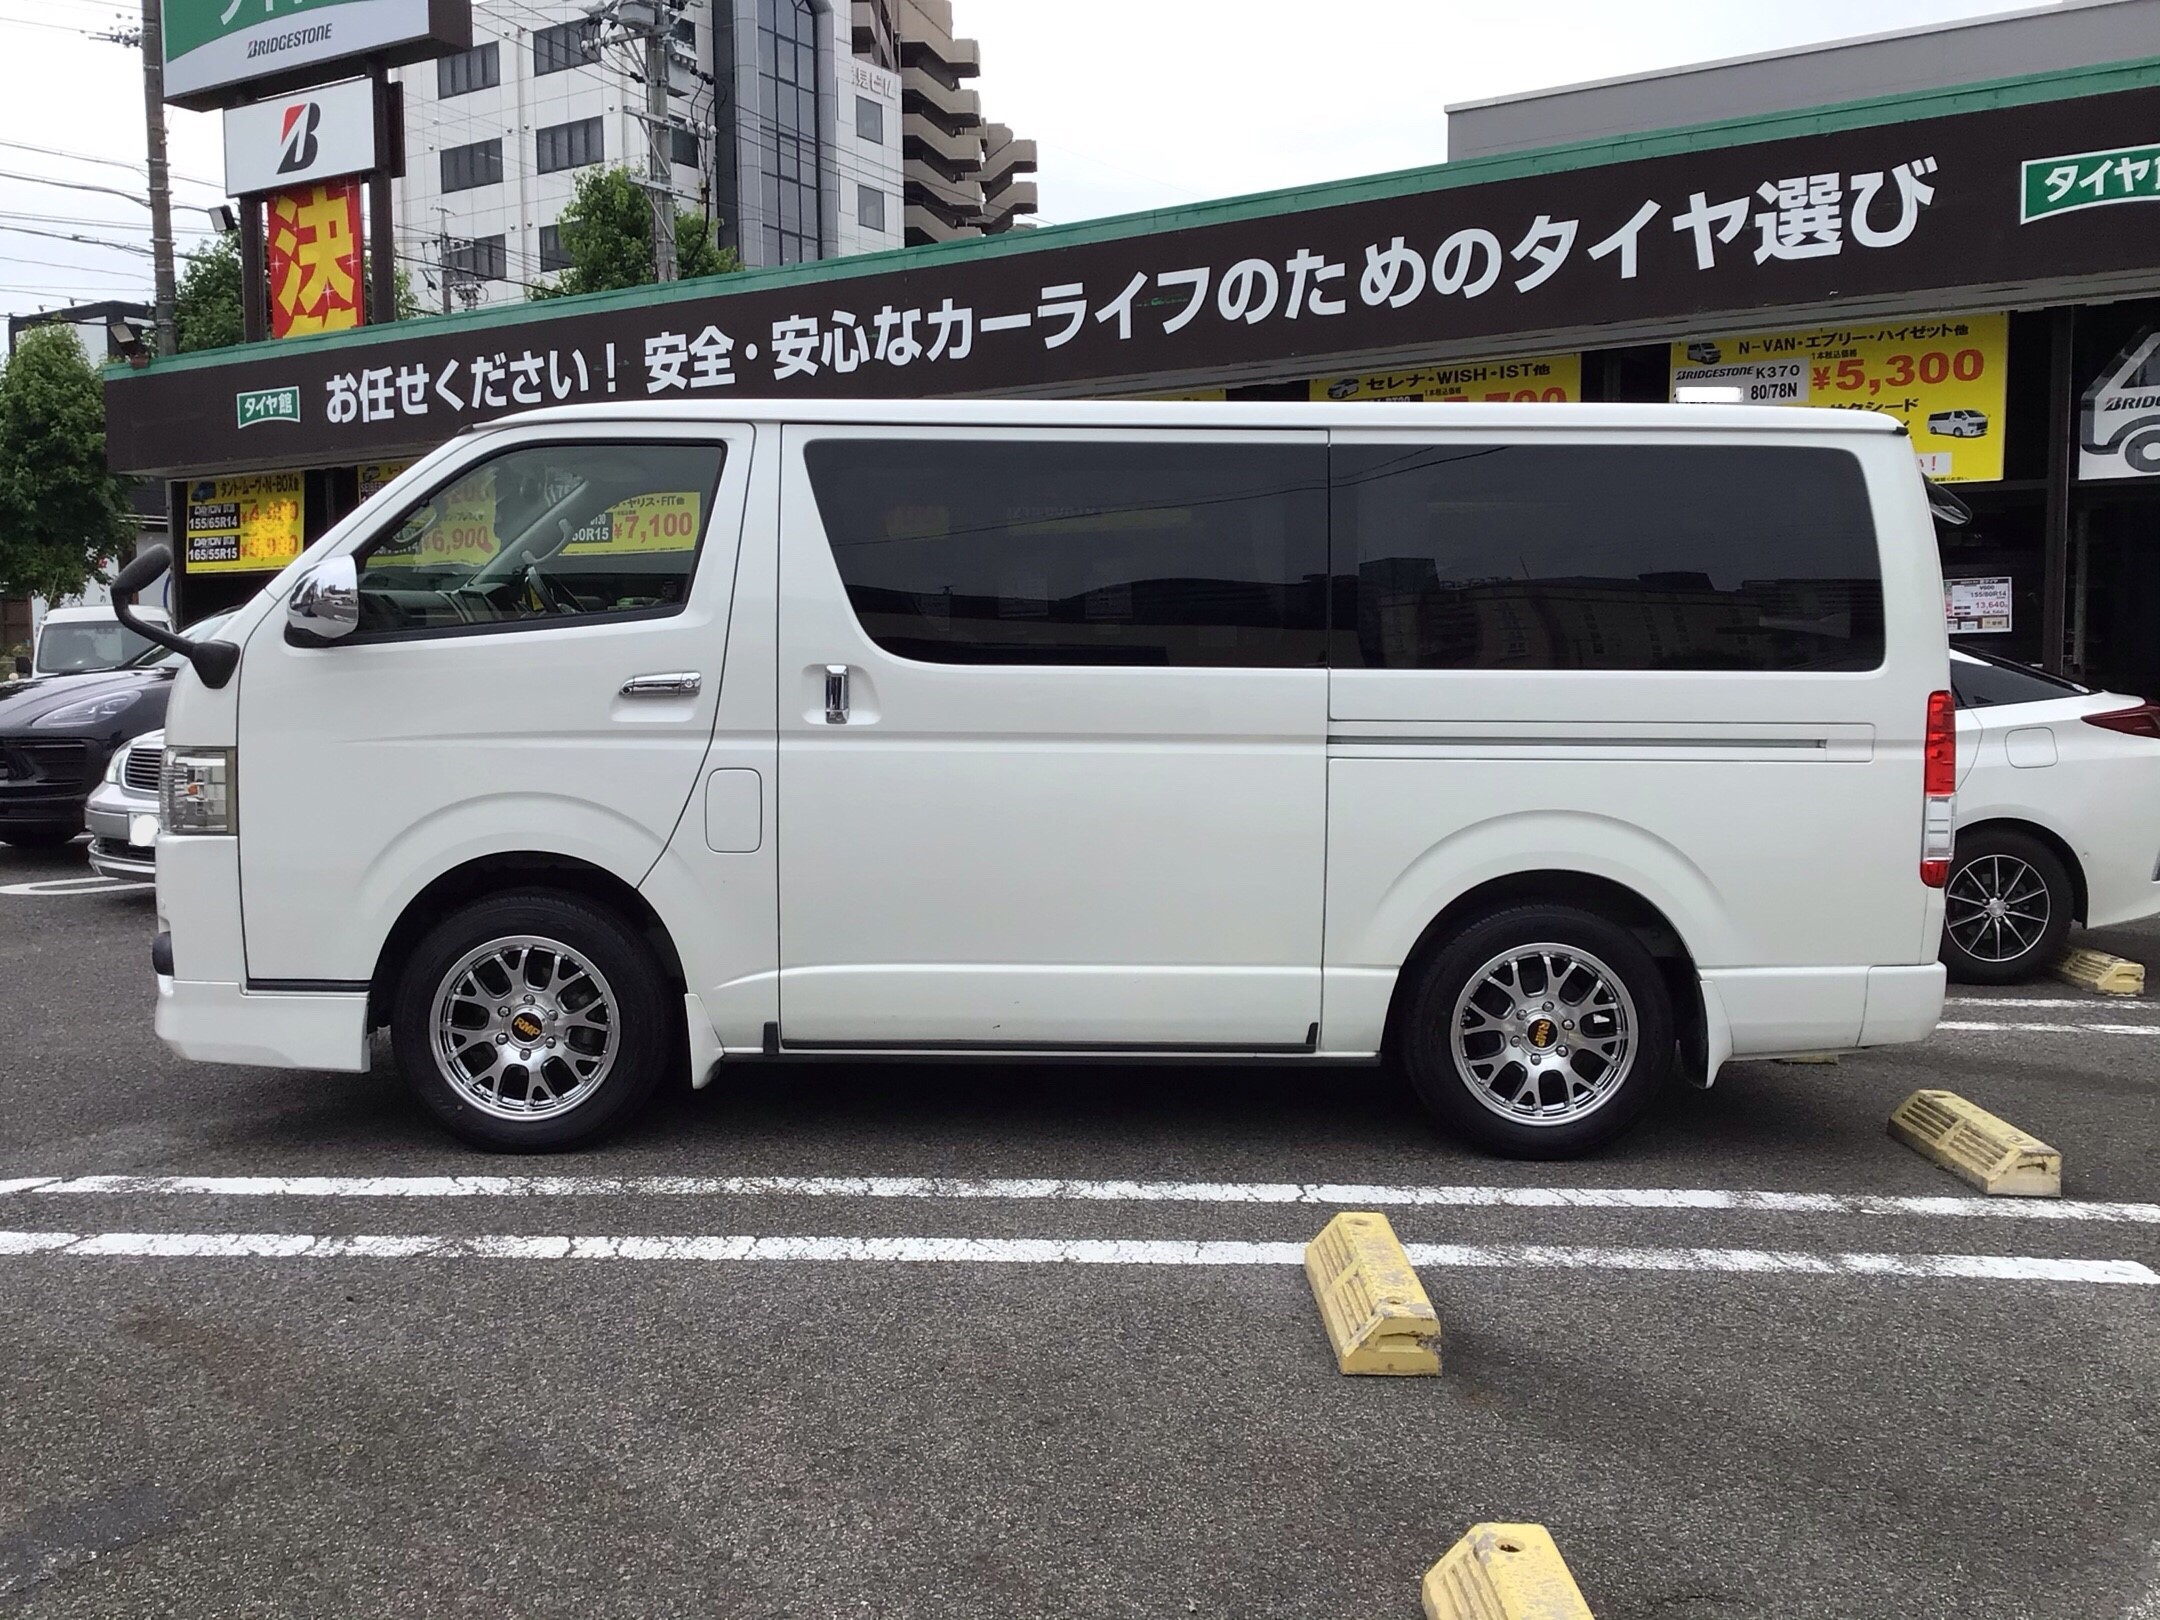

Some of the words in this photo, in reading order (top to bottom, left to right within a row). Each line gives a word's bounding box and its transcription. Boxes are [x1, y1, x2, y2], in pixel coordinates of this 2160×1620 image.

[247, 23, 332, 59] BRIDGESTONE
[2044, 157, 2160, 203] タイヤ
[326, 343, 617, 424] お任せください！
[644, 155, 1939, 394] 安全・安心なカーライフのためのタイヤ選び
[1676, 366, 1754, 380] BRIDGESTONE
[1756, 364, 1800, 379] K370
[1812, 348, 1985, 396] ¥5,300
[244, 392, 293, 418] タイヤ館
[1750, 382, 1798, 400] 80/78N
[190, 516, 238, 529] 155/65R14
[614, 511, 693, 543] ¥7,100
[189, 547, 238, 560] 165/55R15
